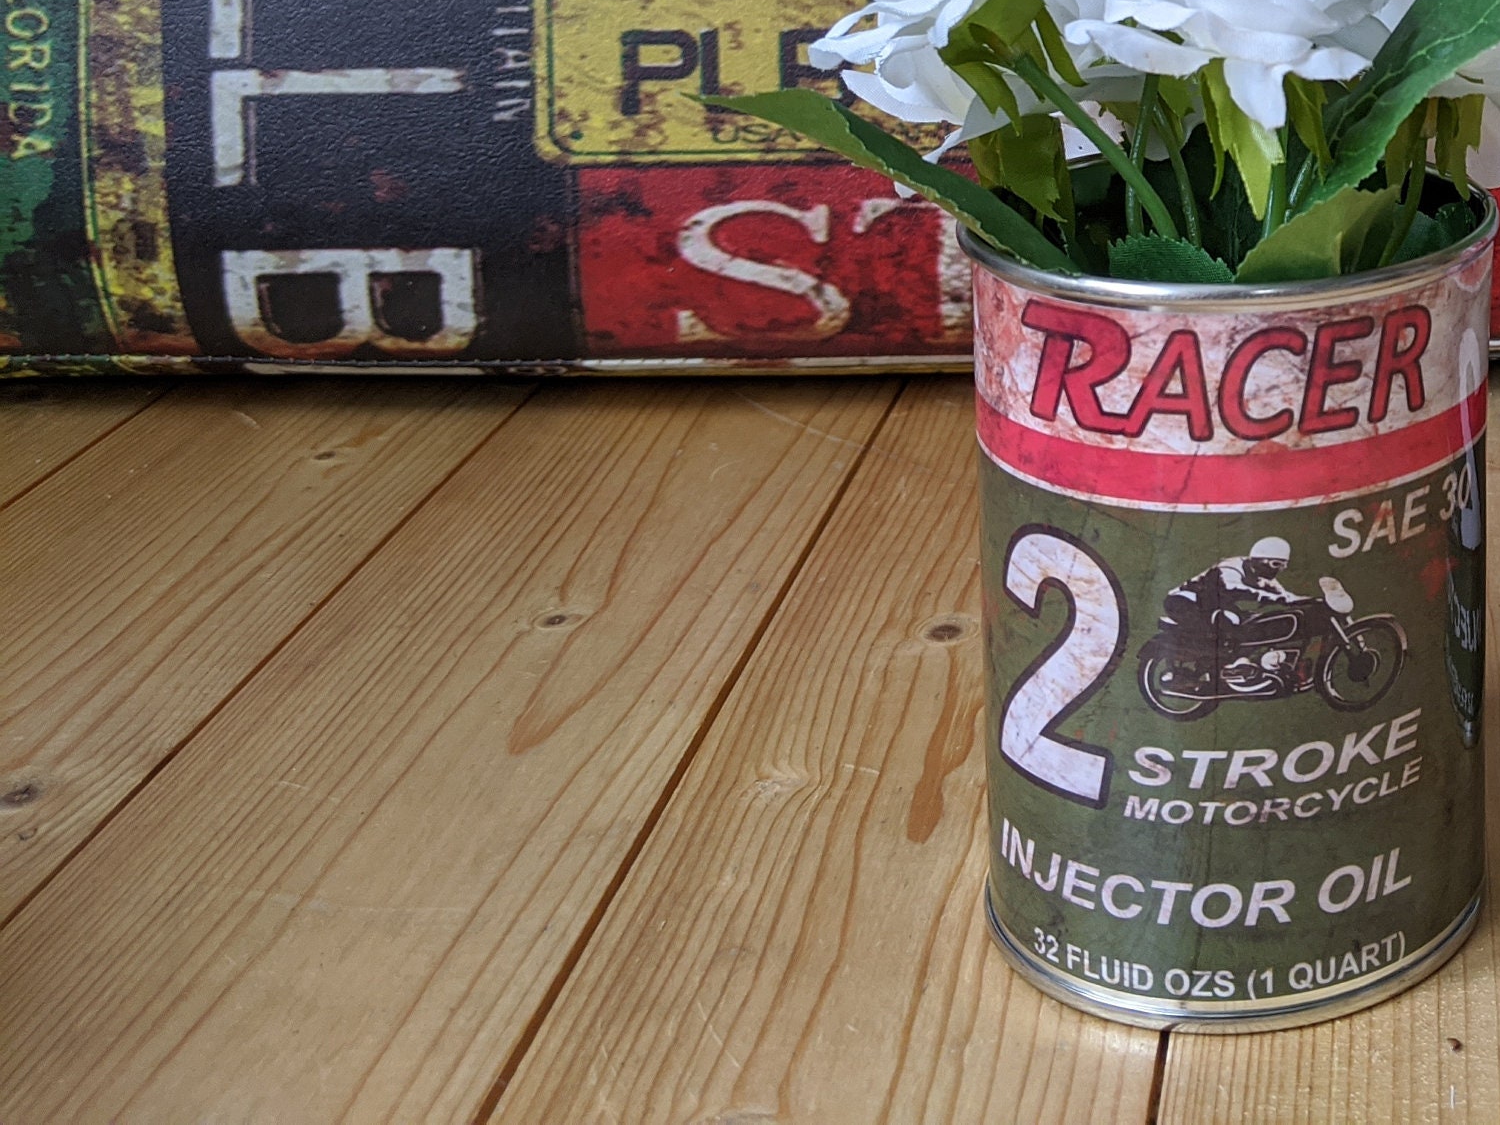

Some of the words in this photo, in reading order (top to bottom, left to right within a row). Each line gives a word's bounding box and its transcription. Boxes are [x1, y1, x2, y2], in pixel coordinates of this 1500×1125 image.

[1022, 298, 1432, 442] RACER
[1328, 487, 1430, 559] SAE
[1440, 461, 1474, 522] 30
[1001, 523, 1129, 809] 2
[1123, 755, 1422, 825] MOTORCYCLE
[1128, 707, 1421, 790] STROKE
[999, 817, 1296, 928] INJECTOR
[1317, 847, 1413, 914] OIL
[1032, 926, 1060, 964] 32
[1066, 937, 1154, 992] FLUID
[1165, 970, 1236, 999] OZS
[1246, 968, 1274, 1000] (1
[1288, 930, 1407, 992] QUART)
